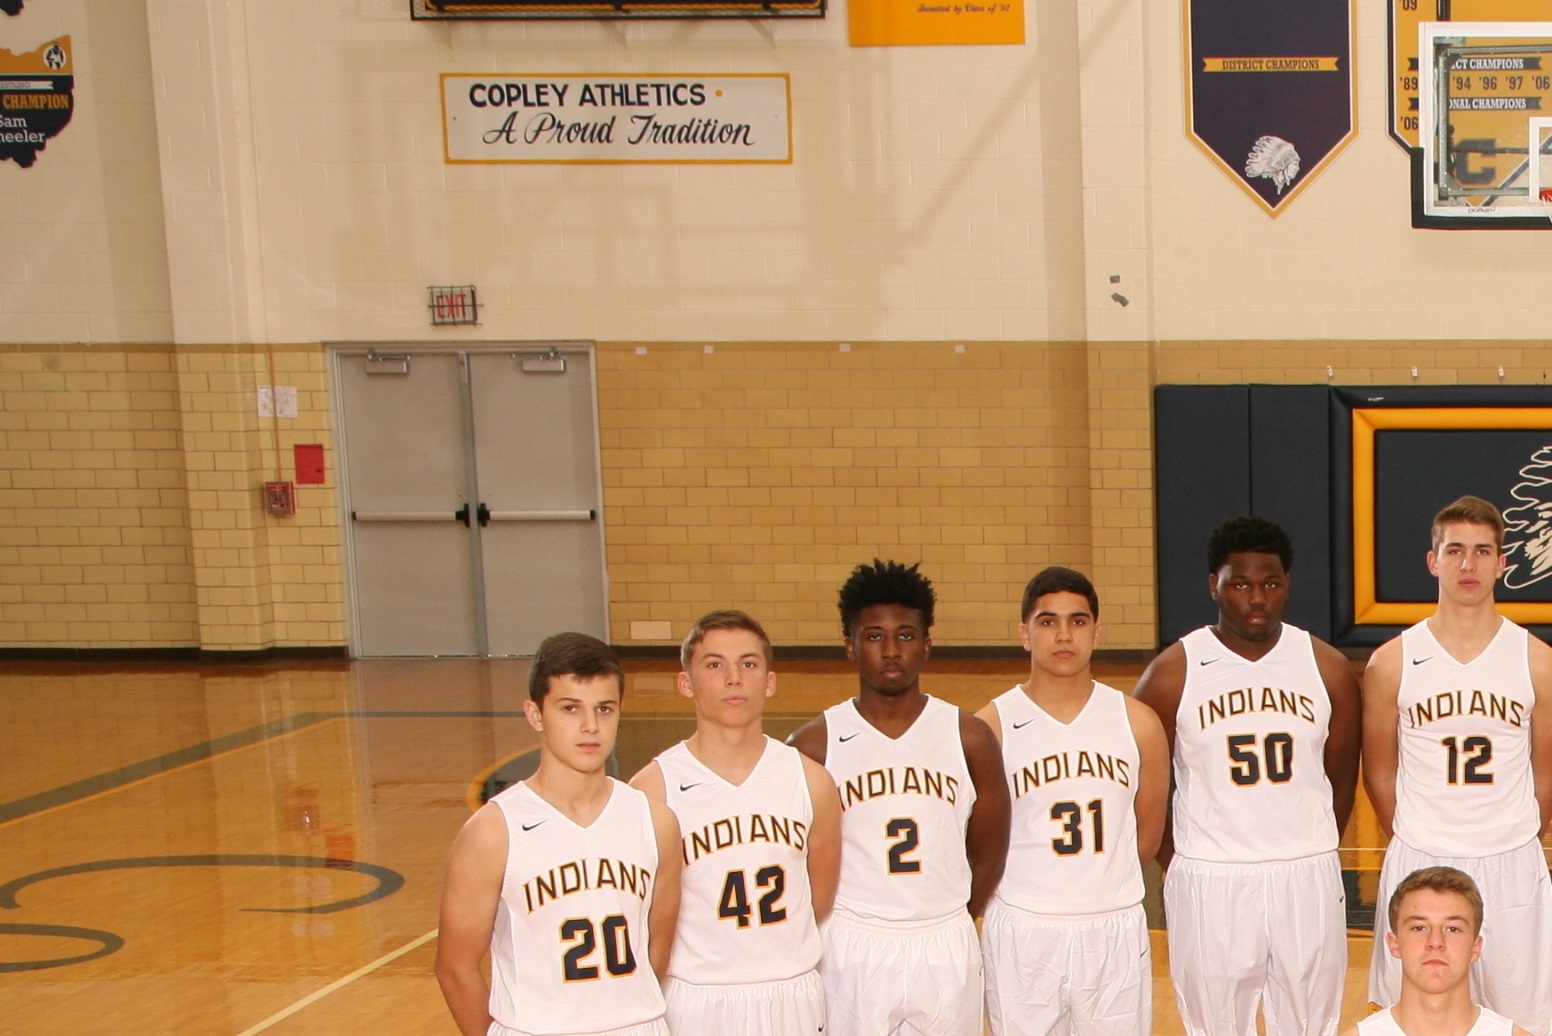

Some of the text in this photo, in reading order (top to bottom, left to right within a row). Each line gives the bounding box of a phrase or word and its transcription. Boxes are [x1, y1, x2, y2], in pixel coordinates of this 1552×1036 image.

[1222, 59, 1320, 70] DISTRICT CHAMPIONS
[1453, 76, 1471, 91] '94
[1479, 76, 1497, 91] '96
[1505, 75, 1523, 91] '97
[1532, 75, 1550, 90] '06
[1469, 58, 1524, 70] CHAMPIONS
[2, 93, 69, 109] CHAMPION
[469, 83, 706, 107] COPLEY ATHLETICS
[1472, 98, 1527, 110] CHAMPIONS
[482, 110, 756, 147] A Proud Tradition
[1196, 687, 1317, 732] INDIANS
[1407, 689, 1525, 729] INDIANS
[1011, 750, 1132, 801] INDIANS
[1225, 731, 1297, 788] 50
[1440, 735, 1495, 787] 12
[838, 766, 959, 814] INDIANS
[682, 813, 808, 867] INDIANS
[884, 816, 922, 877] 2
[1048, 797, 1106, 858] 31
[522, 856, 651, 916] INDIANS
[716, 863, 789, 931] 42
[558, 913, 637, 984] 20
